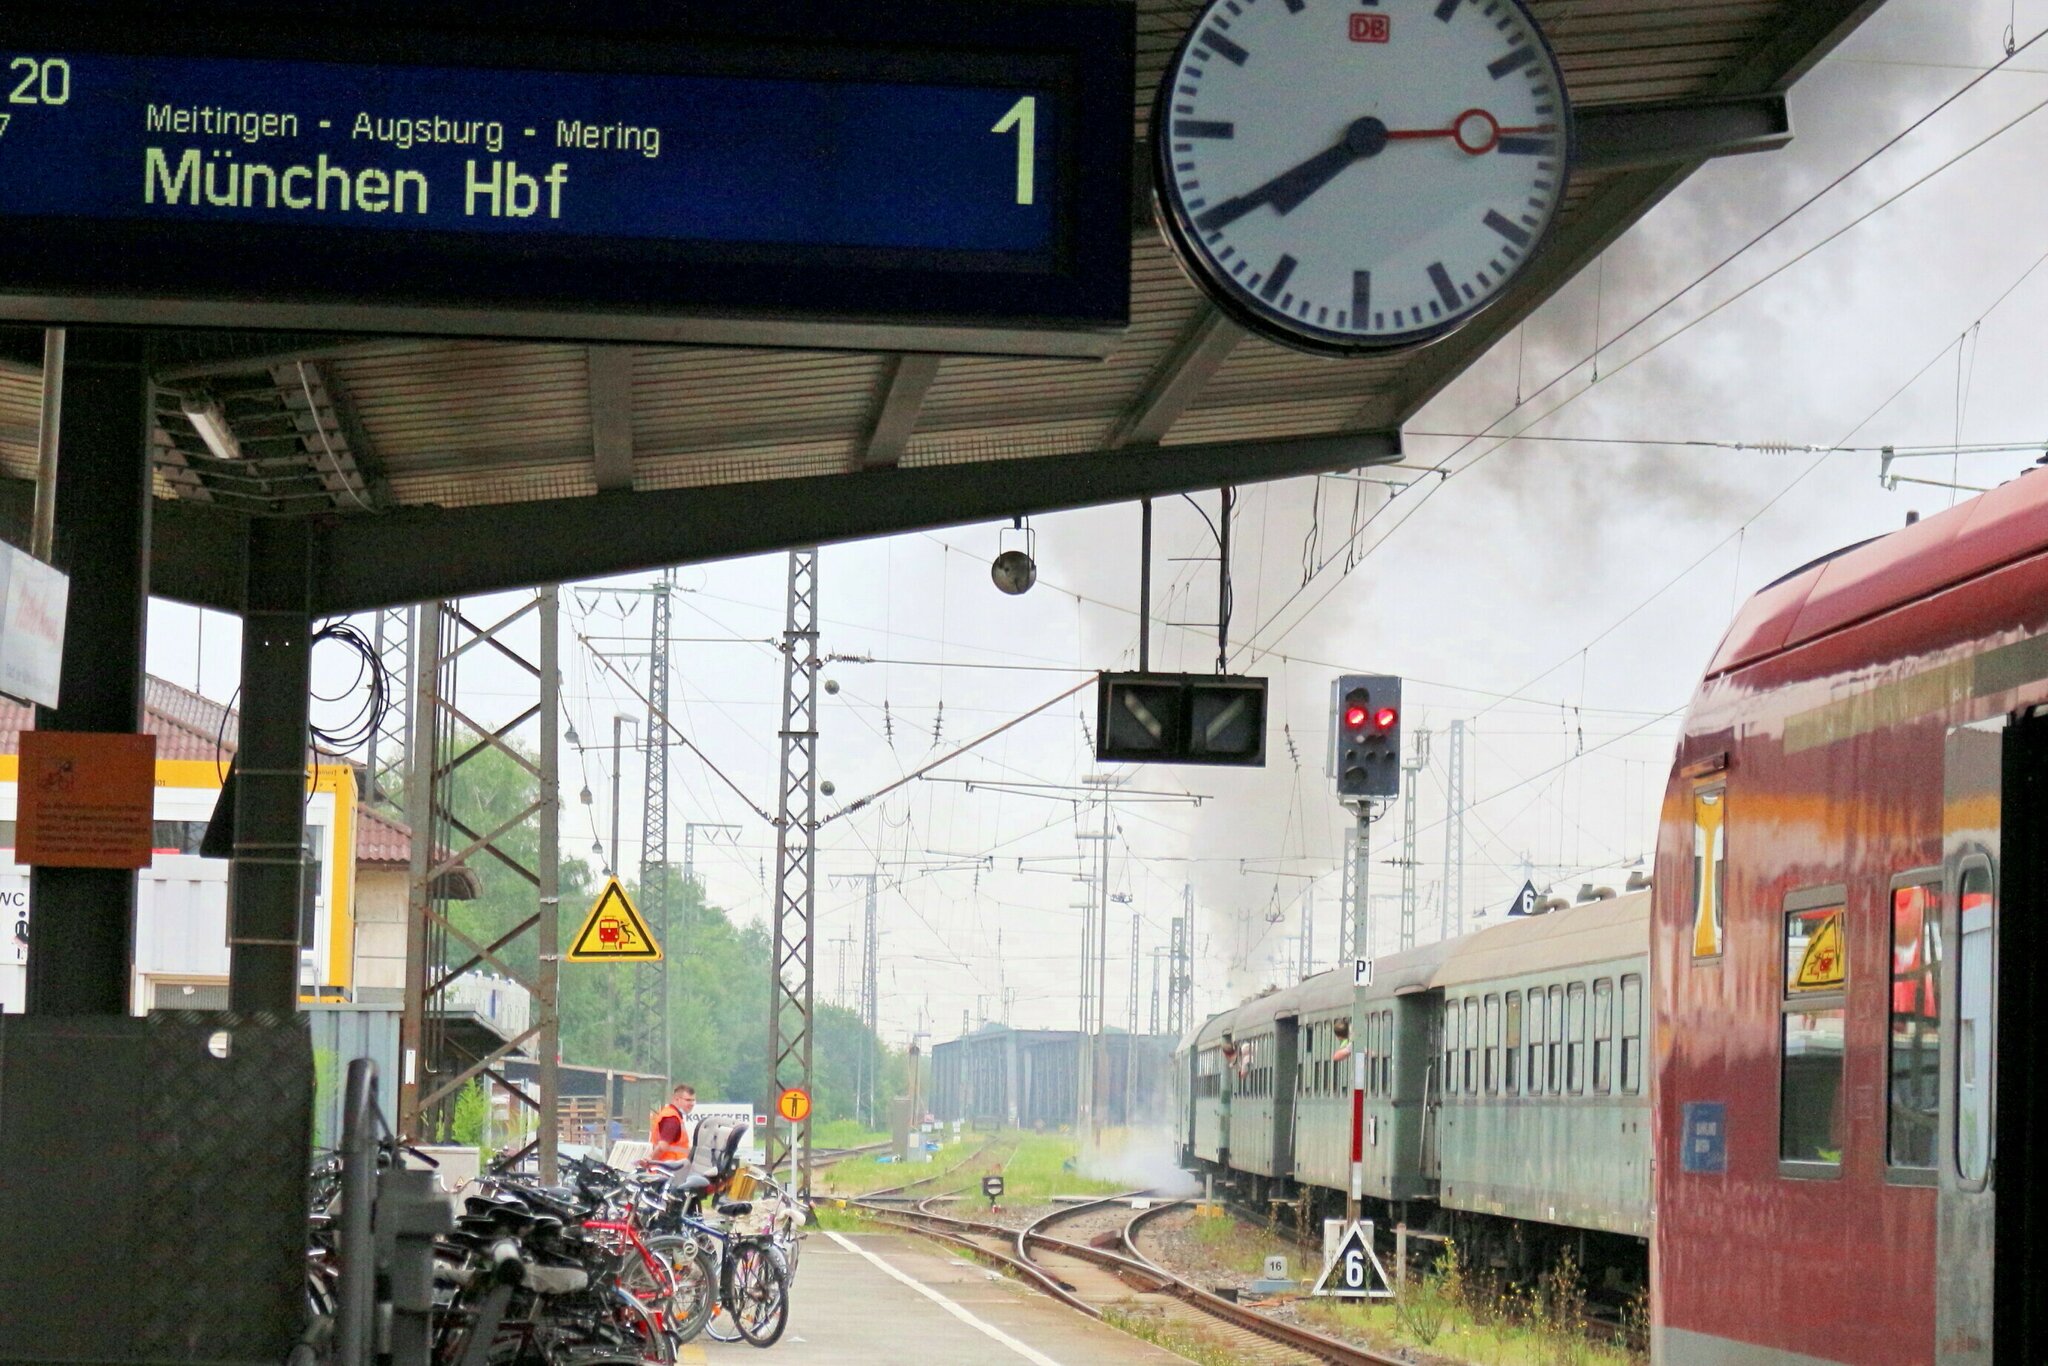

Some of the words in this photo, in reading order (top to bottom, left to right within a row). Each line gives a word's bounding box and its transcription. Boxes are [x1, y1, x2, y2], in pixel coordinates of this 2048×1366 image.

[1353, 17, 1386, 39] DB
[10, 57, 70, 105] 20
[147, 104, 298, 143] Meitingen
[353, 112, 503, 152] Augsburg
[557, 120, 660, 158] Mering
[991, 96, 1035, 205] 1
[145, 148, 428, 213] München
[465, 160, 568, 219] Hbf
[0, 892, 25, 907] WC
[1523, 890, 1535, 914] 6
[1356, 960, 1372, 982] P1
[1269, 1261, 1282, 1271] 16
[1346, 1250, 1364, 1287] 6
